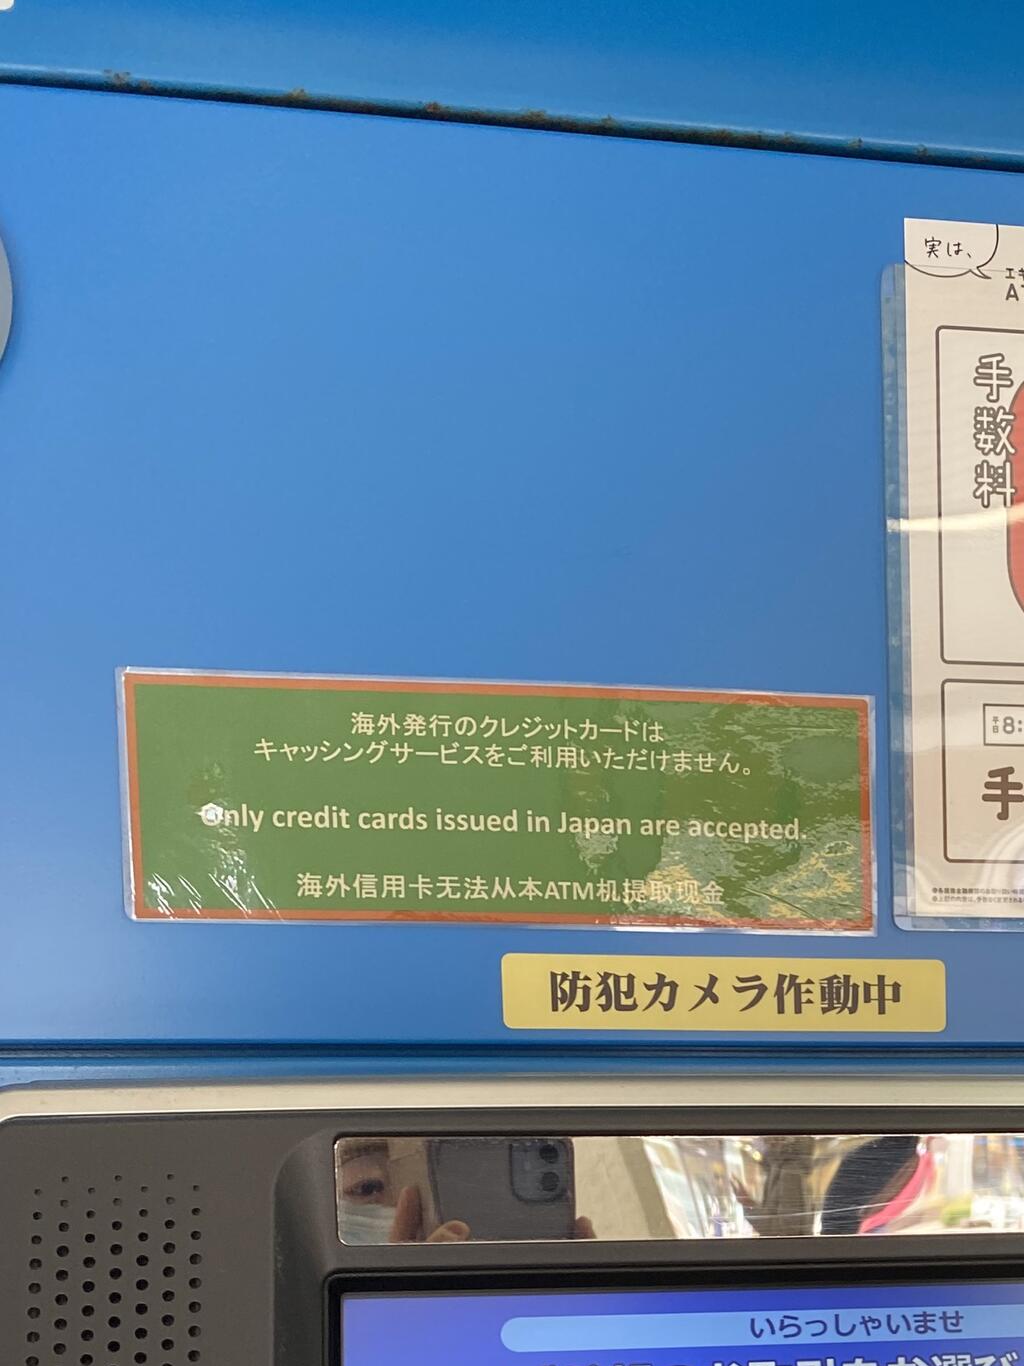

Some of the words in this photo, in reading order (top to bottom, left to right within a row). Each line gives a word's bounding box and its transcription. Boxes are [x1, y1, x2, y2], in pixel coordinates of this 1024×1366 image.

[924, 237, 972, 259] 実は、
[973, 353, 1016, 508] 手数料
[351, 711, 665, 742] 海外発行のクレジットカードは
[254, 738, 752, 776] キャッシングサービスをご利用いただけません。
[200, 803, 263, 833] Only
[272, 805, 350, 829] credit
[358, 807, 428, 830] cards
[436, 807, 518, 832] issued
[527, 811, 550, 833] in
[558, 812, 631, 841] Japan
[640, 816, 680, 836] are
[688, 818, 807, 843] accepted.
[550, 970, 901, 1015] 防犯カメラ作動中
[750, 1310, 964, 1339] いらっしゃいませ
